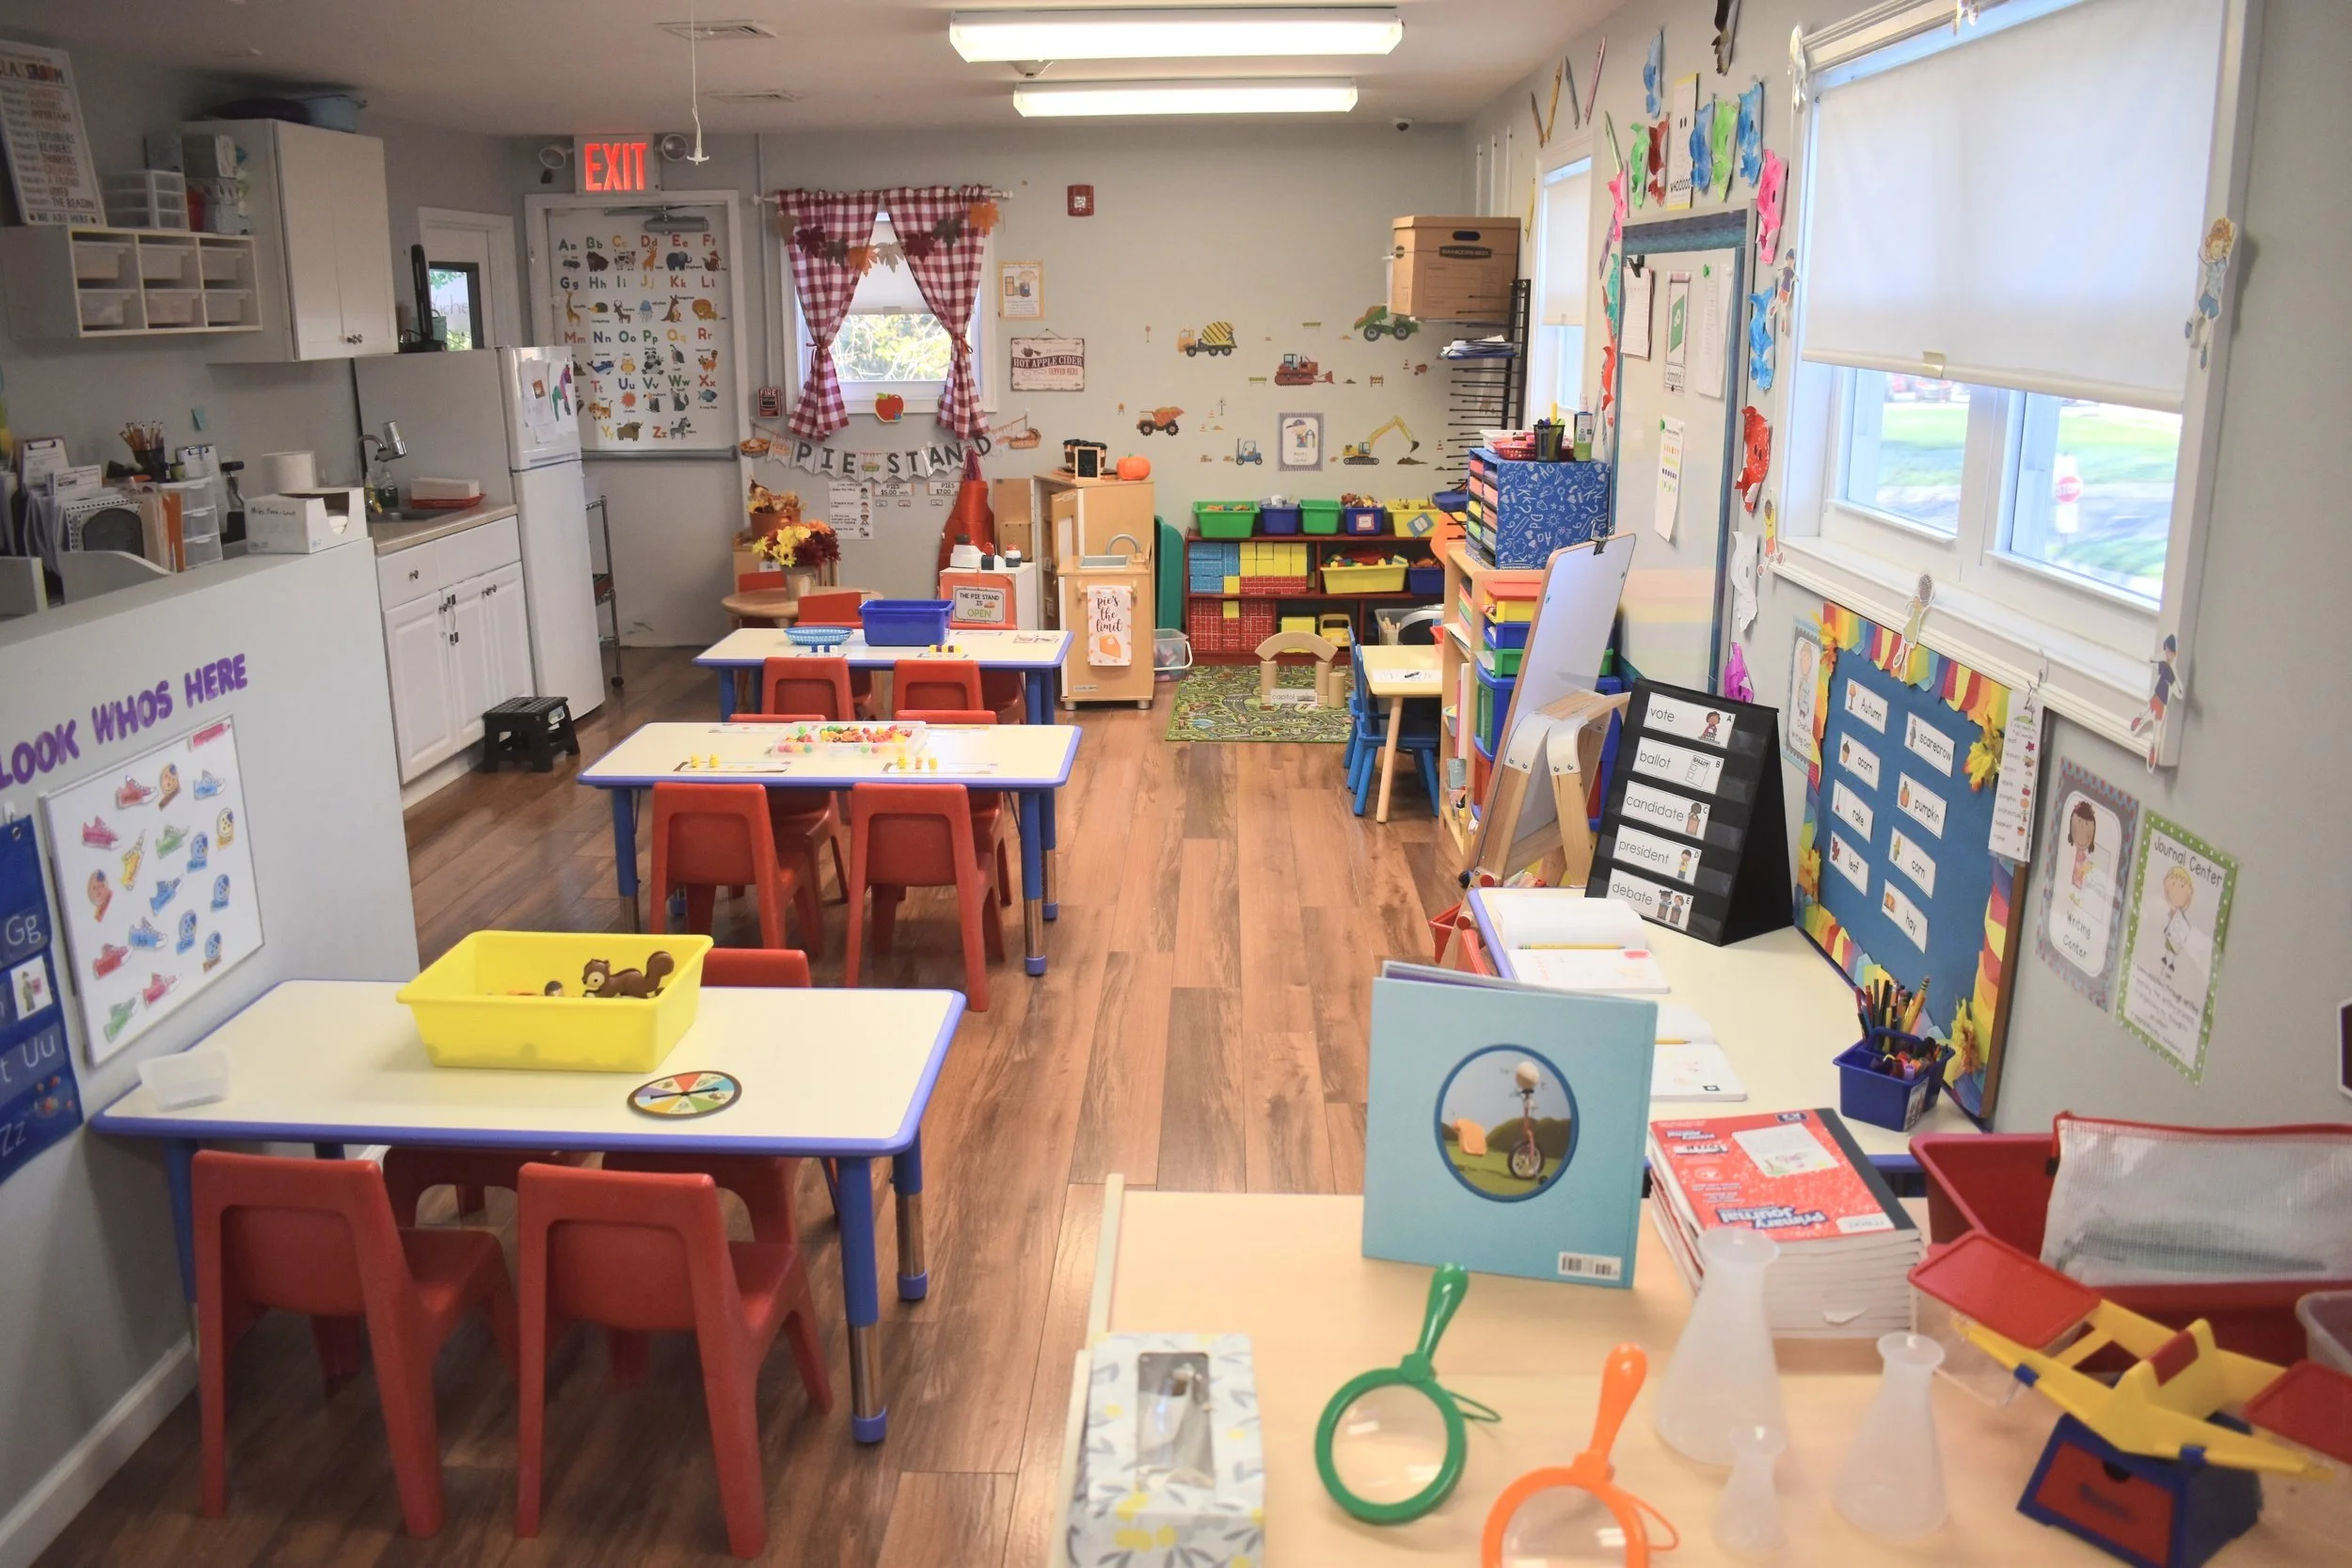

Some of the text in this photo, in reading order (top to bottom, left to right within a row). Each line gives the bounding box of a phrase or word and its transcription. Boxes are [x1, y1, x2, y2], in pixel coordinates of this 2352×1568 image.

[584, 143, 647, 192] EXIT
[558, 234, 716, 251] Aa Bb Cc Dd Ee Ff
[560, 275, 715, 290] Gg Hh Ii Jj Kk Ll
[564, 327, 712, 345] Mm Nn Oo Pp Qq Rr
[1013, 356, 1082, 368] HOT APPLE CIDER
[590, 374, 716, 393] Tt Uu Vv Ww Xx
[601, 425, 667, 440] Yy Zz
[796, 436, 992, 474] PIE STAND
[1097, 594, 1120, 610] pie's
[967, 609, 992, 618] OPEN
[1100, 607, 1118, 621] the
[1096, 619, 1123, 632] limit
[1651, 708, 1675, 722] vote
[1861, 698, 1882, 722] Autumn
[0, 653, 248, 792] LOOK WHOS HERE
[1919, 733, 1951, 761] scarecrow
[1640, 750, 1672, 768] ballot
[1693, 757, 1709, 768] BALLOT
[1857, 755, 1873, 773] acorn
[1626, 796, 1684, 822] candidate
[1851, 809, 1865, 827] rake
[1914, 799, 1940, 824] pumpkin
[1618, 839, 1670, 864] president
[1849, 853, 1860, 875] leaf
[1911, 859, 1926, 879] corn
[2153, 836, 2222, 888] Journal Center
[1612, 882, 1653, 906] debate
[6, 913, 41, 945] Gg
[1905, 911, 1916, 936] hay
[2067, 910, 2091, 941] Writing
[2062, 934, 2088, 958] Center
[23, 1034, 56, 1069] Uu
[1, 1121, 27, 1158] Zz
[1716, 1205, 1794, 1223] Journal
[1753, 1212, 1828, 1229] Primary
